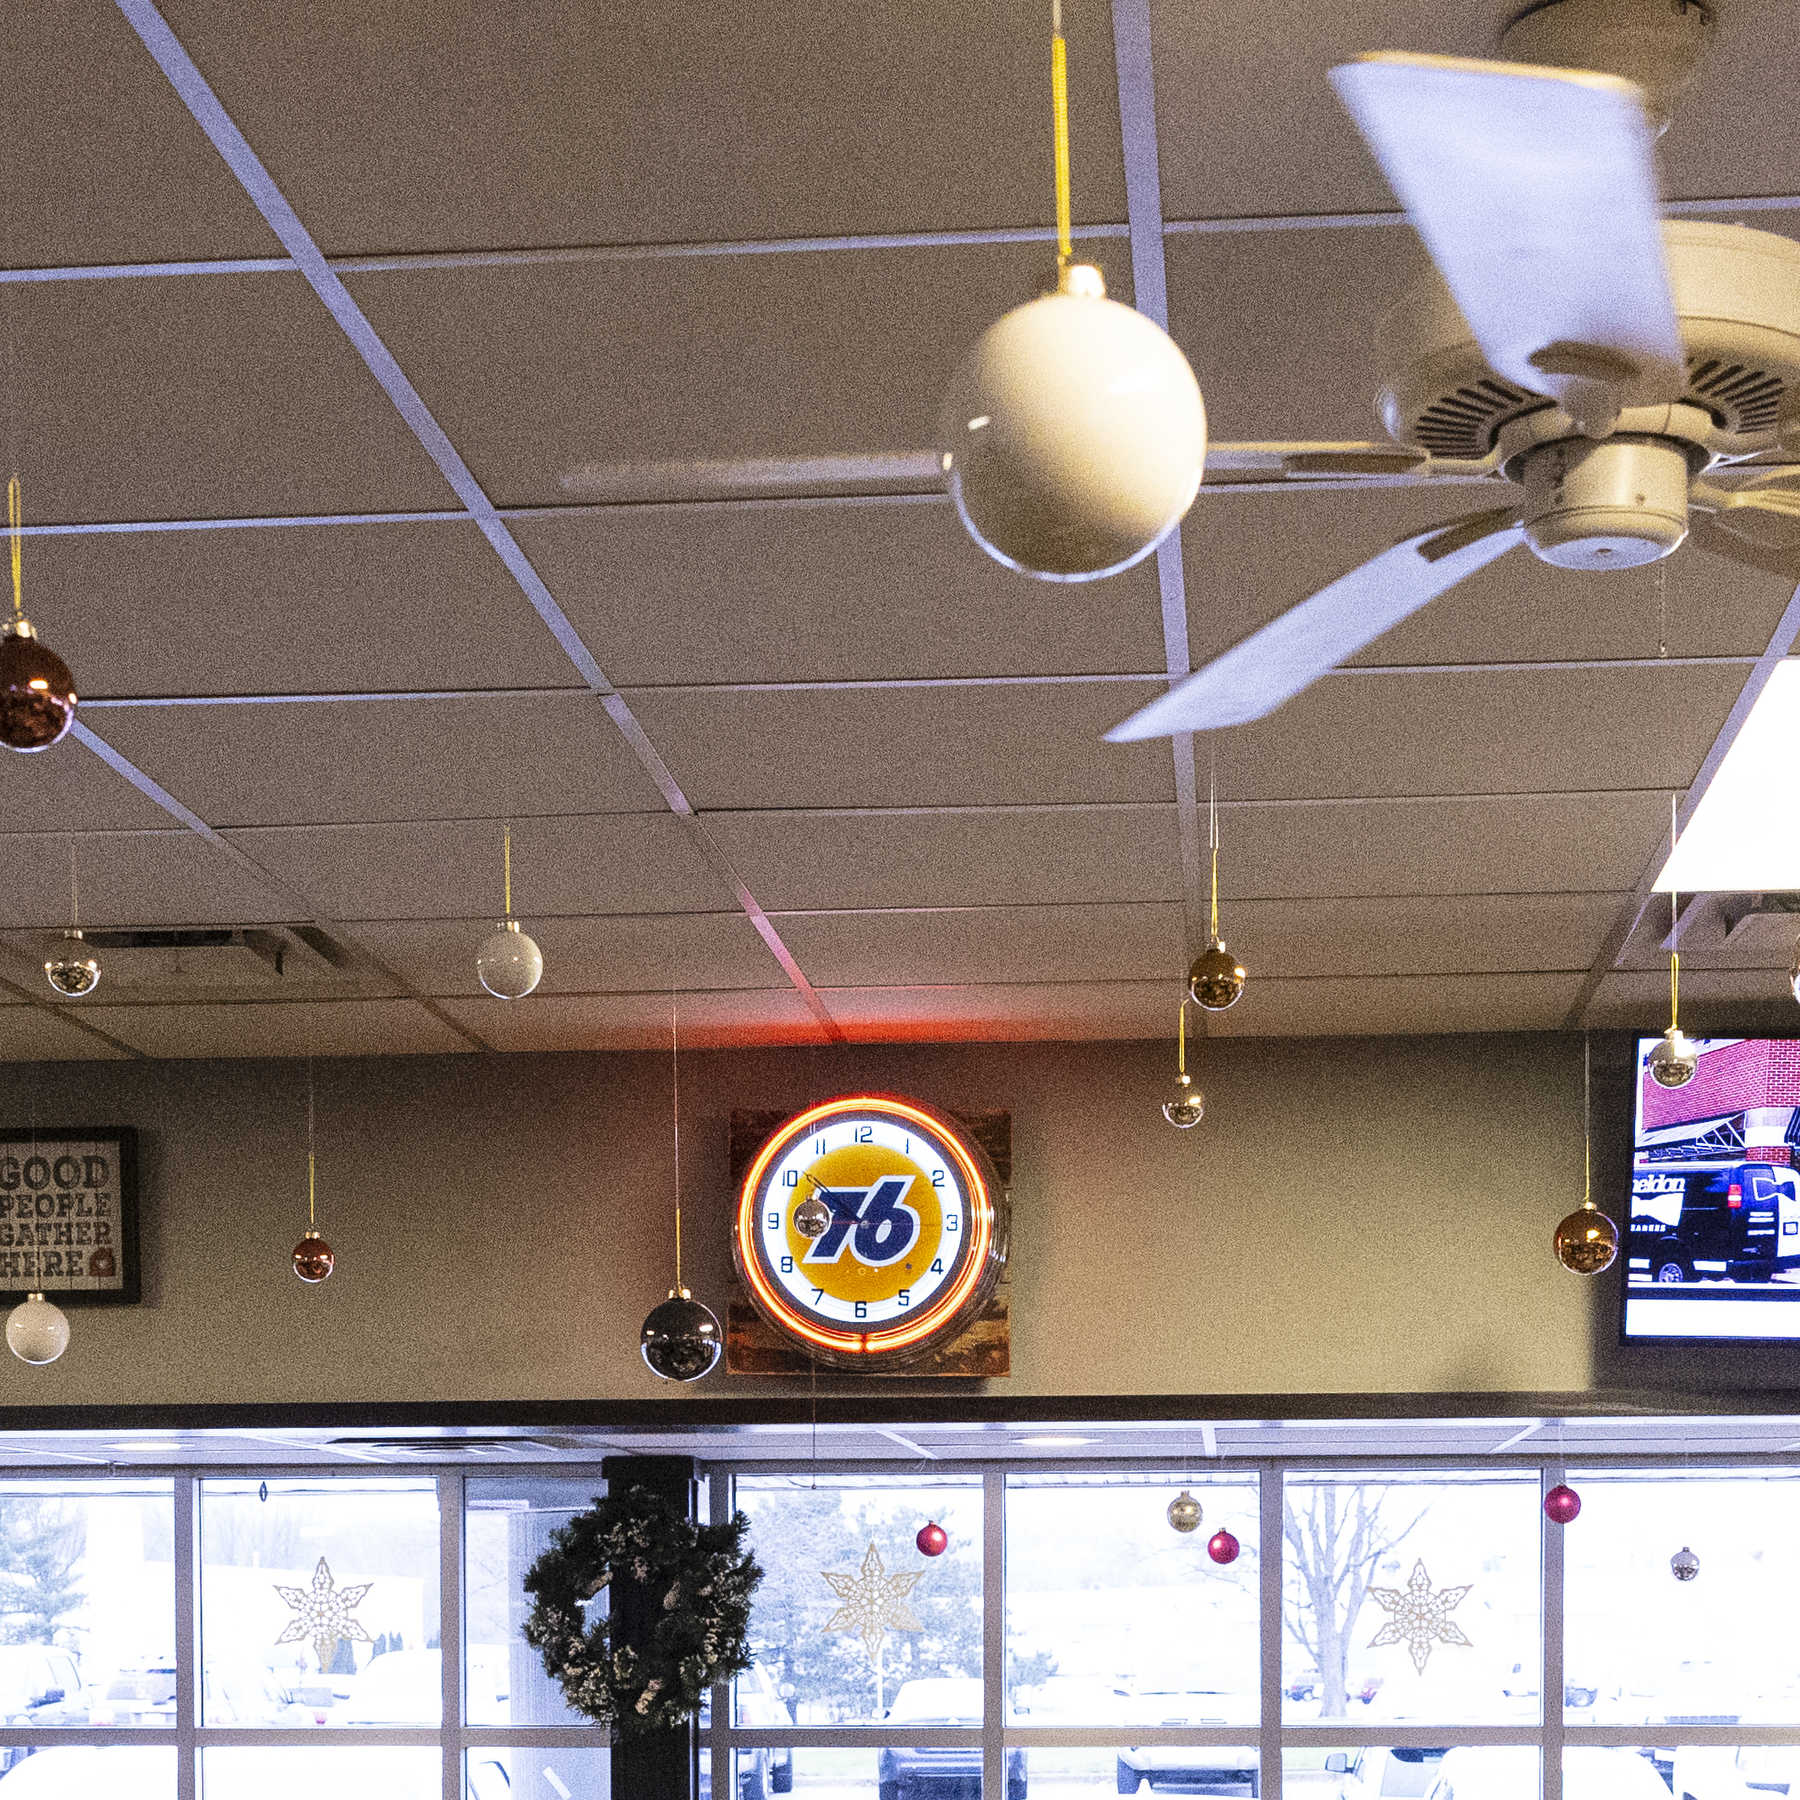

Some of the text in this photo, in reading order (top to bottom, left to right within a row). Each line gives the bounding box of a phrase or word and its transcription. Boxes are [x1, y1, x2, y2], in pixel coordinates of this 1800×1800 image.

[855, 1126, 873, 1143] 12
[815, 1139, 826, 1155] 11
[905, 1138, 910, 1154] 1
[782, 1170, 798, 1187] 10
[932, 1170, 945, 1187] 2
[768, 1213, 780, 1229] 9
[802, 1175, 920, 1267] 76
[946, 1214, 958, 1231] 3
[781, 1256, 793, 1273] 8
[931, 1258, 944, 1275] 4
[811, 1288, 825, 1306] 7
[898, 1289, 910, 1306] 5
[854, 1301, 867, 1318] 6
